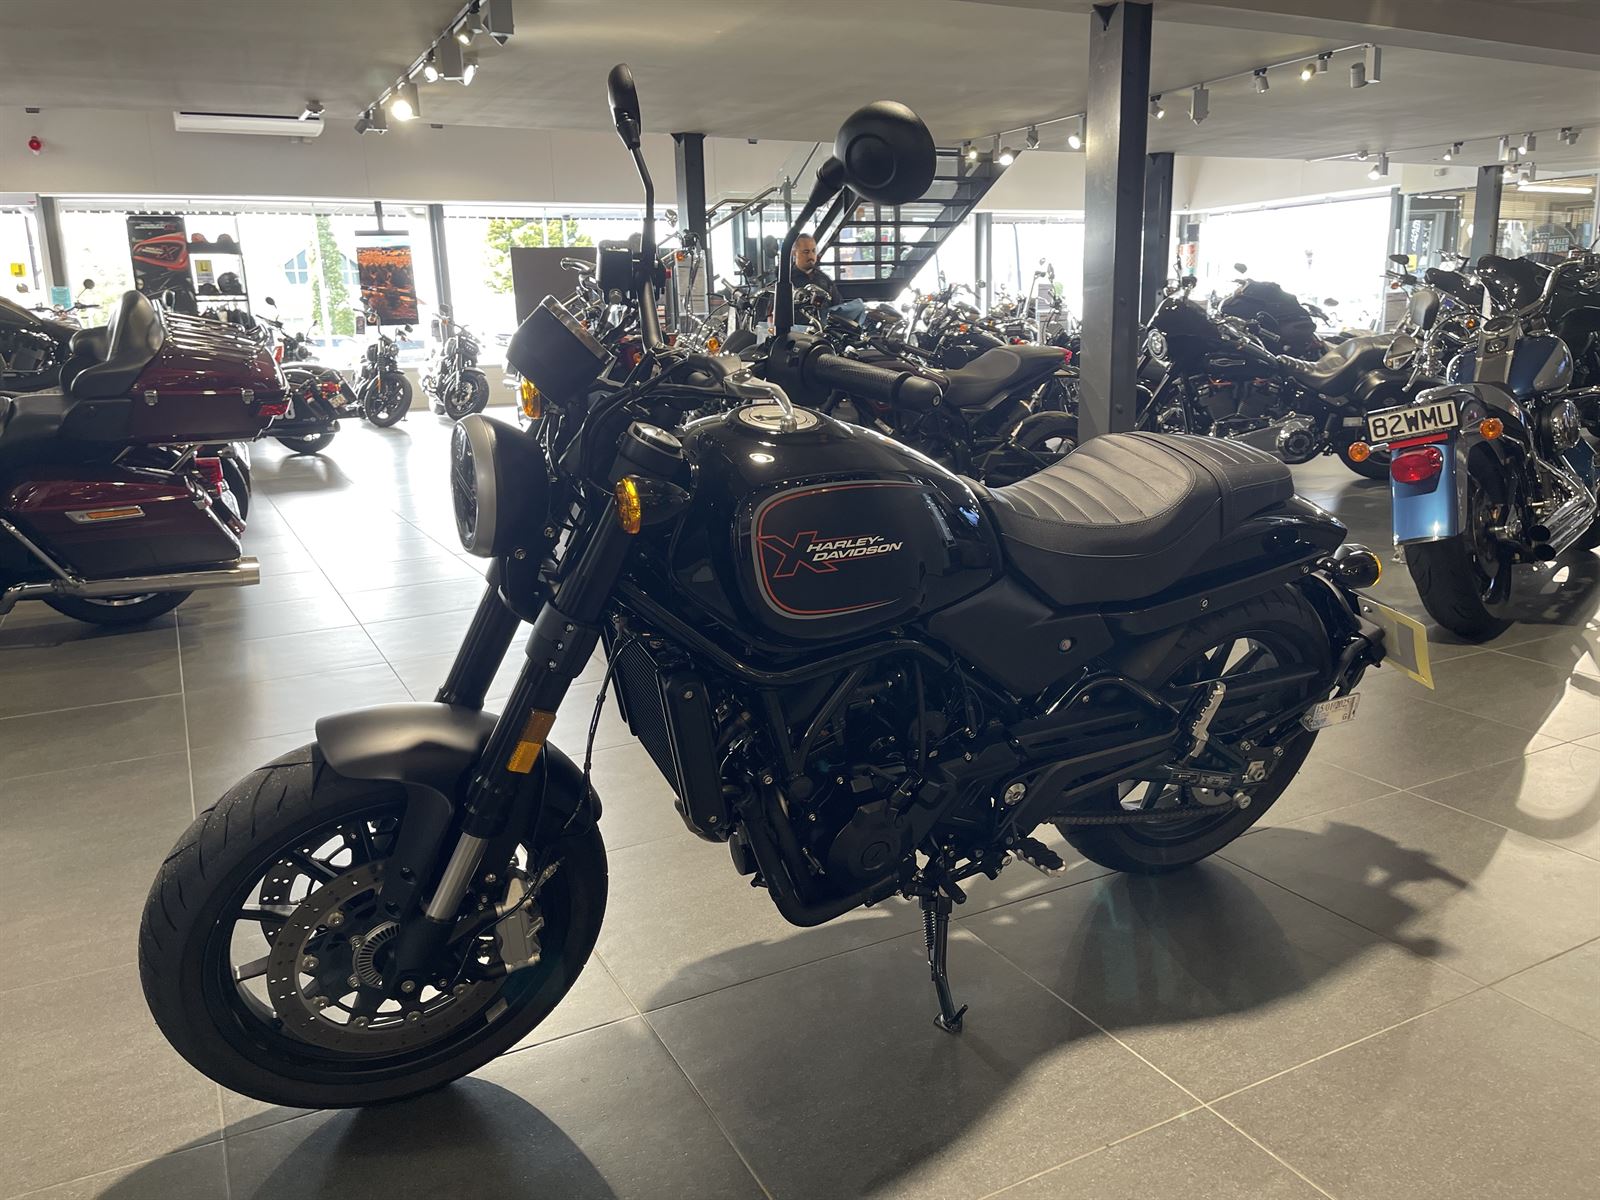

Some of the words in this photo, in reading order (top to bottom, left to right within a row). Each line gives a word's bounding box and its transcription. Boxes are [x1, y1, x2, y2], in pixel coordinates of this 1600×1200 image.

[1372, 403, 1455, 438] 82WMU
[806, 535, 885, 553] HARLEY-
[812, 541, 904, 562] DAVIDSON
